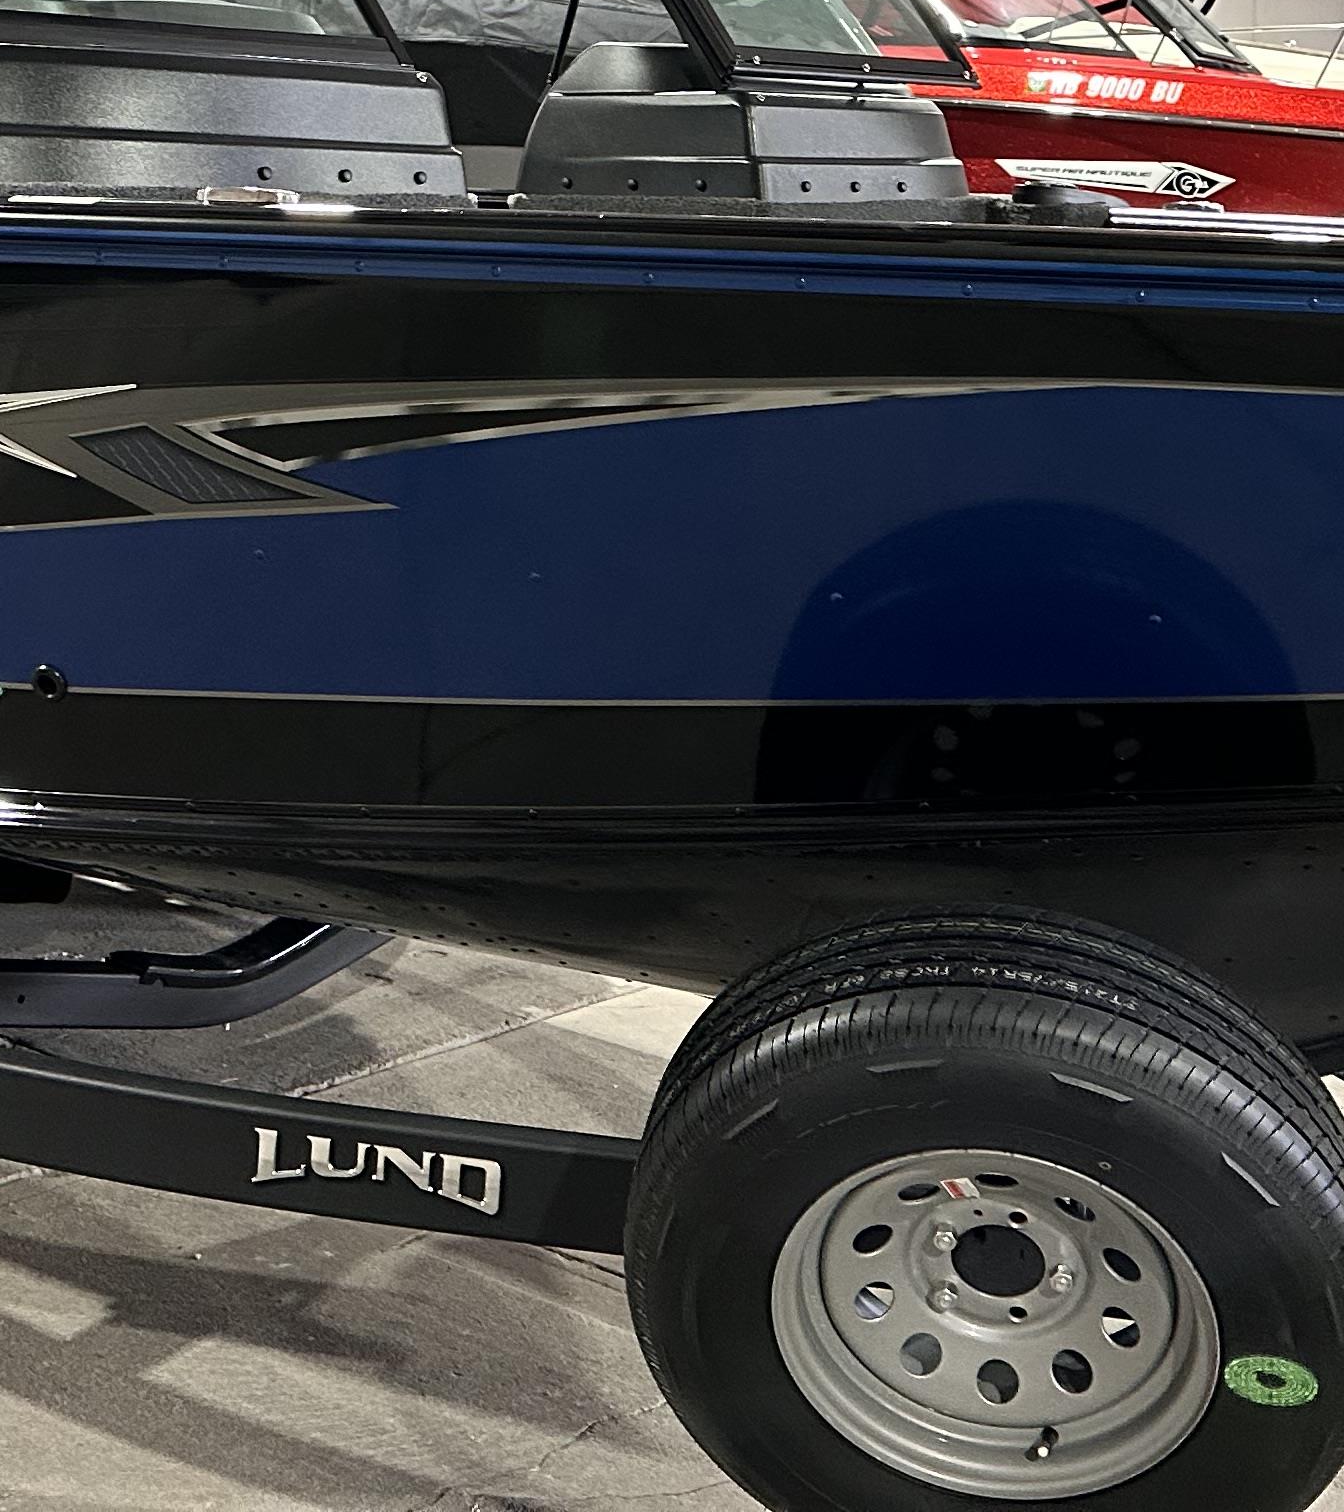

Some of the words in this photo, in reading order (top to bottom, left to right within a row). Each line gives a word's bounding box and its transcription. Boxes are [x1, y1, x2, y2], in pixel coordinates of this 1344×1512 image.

[1086, 74, 1146, 101] 9000
[1150, 80, 1185, 104] BU
[1015, 165, 1060, 174] SUPER
[250, 1127, 502, 1216] LUND
